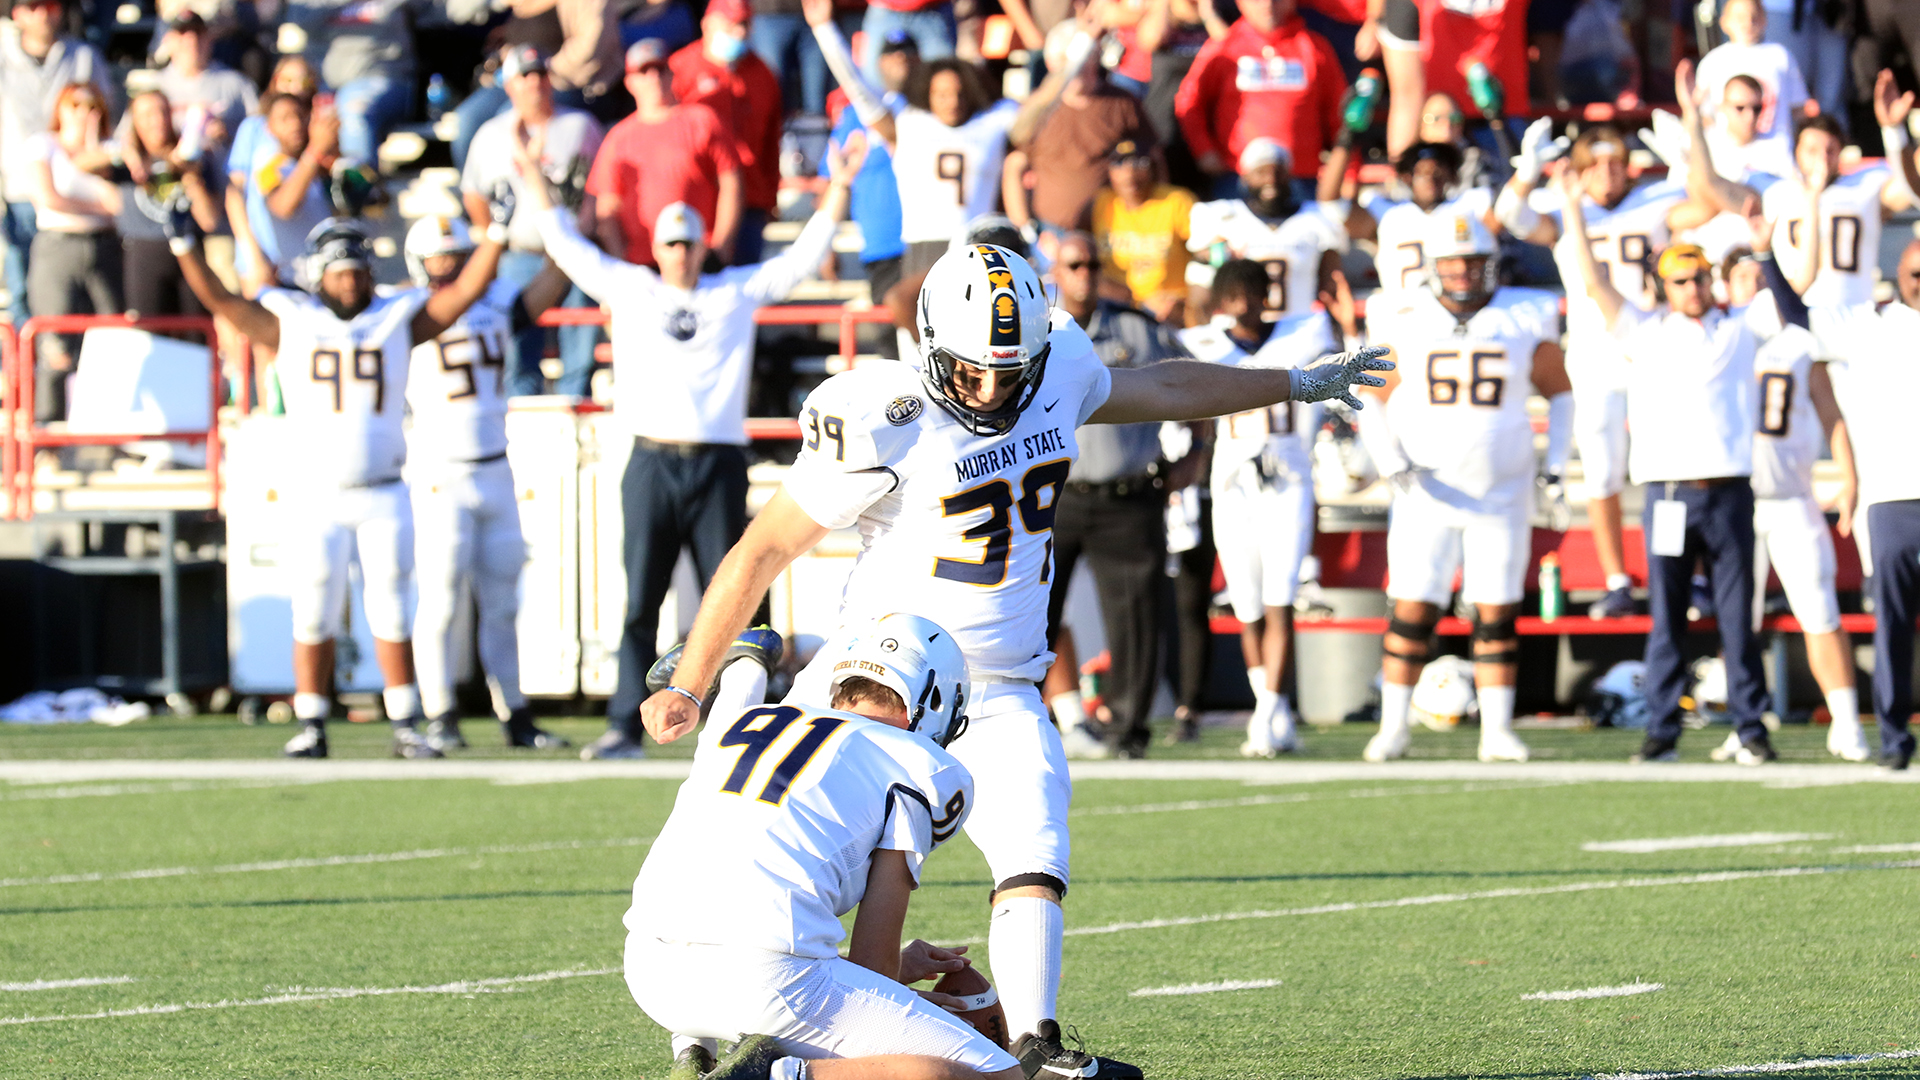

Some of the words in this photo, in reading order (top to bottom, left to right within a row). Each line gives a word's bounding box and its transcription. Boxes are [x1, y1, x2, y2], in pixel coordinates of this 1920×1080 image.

[936, 151, 966, 207] 9
[311, 347, 385, 415] 99
[437, 331, 505, 402] 54
[991, 350, 1019, 359] Riddell
[1426, 349, 1507, 407] 66
[807, 406, 845, 463] 39
[954, 442, 1018, 482] MURRAY
[1023, 427, 1066, 460] STATE
[931, 457, 1072, 588] 39
[859, 660, 886, 676] STATE
[717, 705, 851, 808] 91
